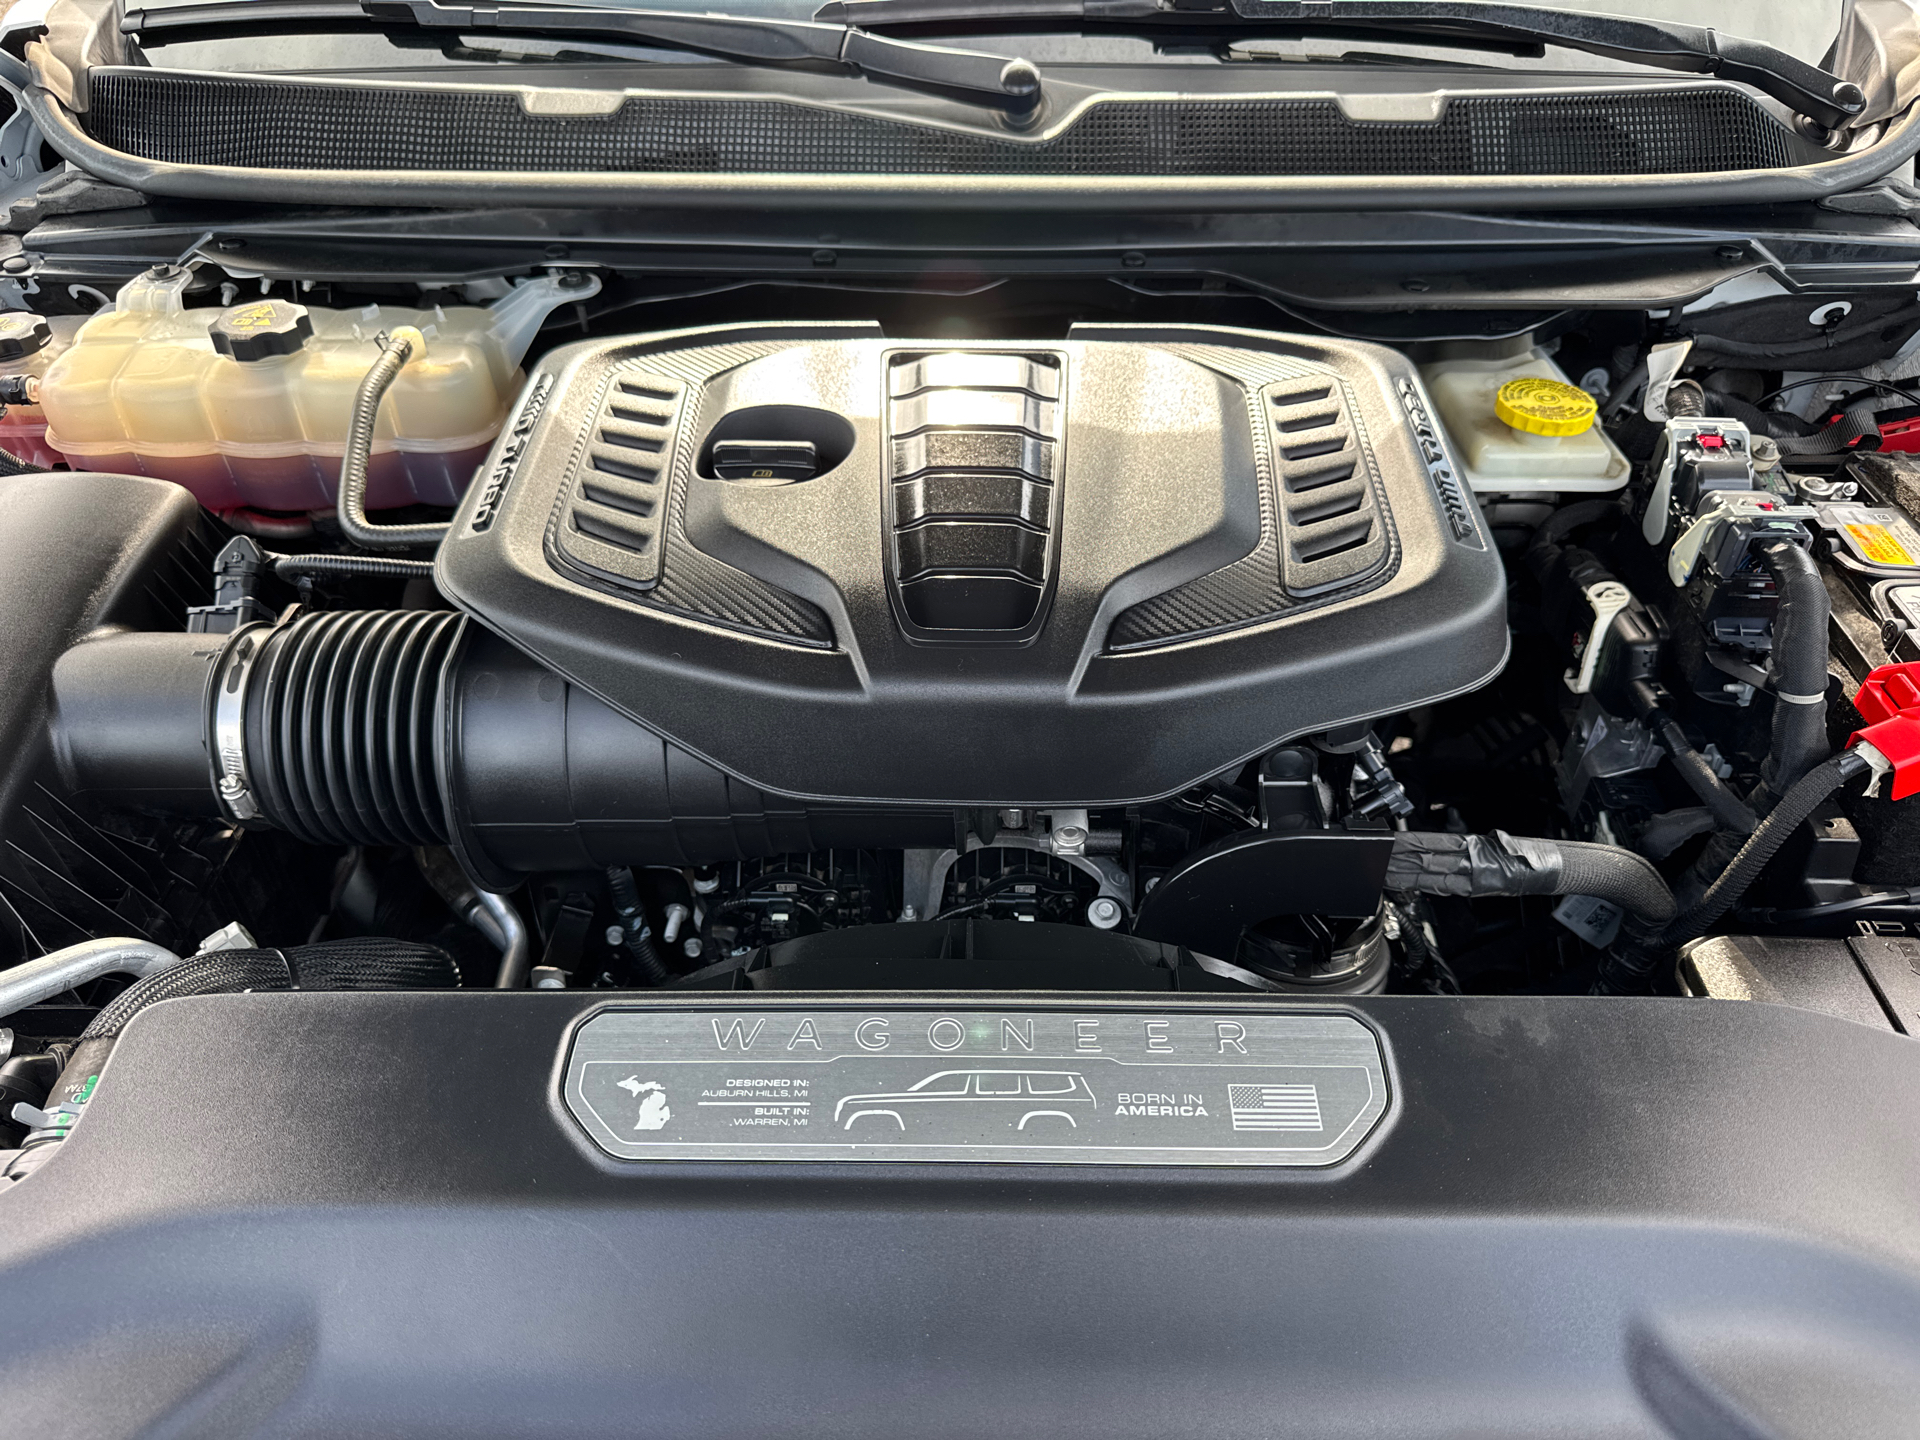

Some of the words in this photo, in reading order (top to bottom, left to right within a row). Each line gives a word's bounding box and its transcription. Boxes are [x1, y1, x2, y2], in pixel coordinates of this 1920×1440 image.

[1398, 377, 1443, 465] TURBO
[472, 434, 526, 533] TURBO
[711, 1017, 1248, 1054] WAGONEER
[726, 1079, 791, 1087] DESIGNED
[792, 1079, 810, 1087] IN:
[701, 1089, 754, 1097] AUBURN
[755, 1089, 792, 1098] HILLS,
[794, 1089, 808, 1097] MI
[1117, 1093, 1176, 1104] BORN
[1183, 1093, 1203, 1105] IN
[754, 1107, 791, 1115] BUILT
[793, 1107, 810, 1116] IN:
[1114, 1105, 1209, 1117] AMERICA
[733, 1118, 791, 1127] WARREN,
[793, 1118, 808, 1126] MI
